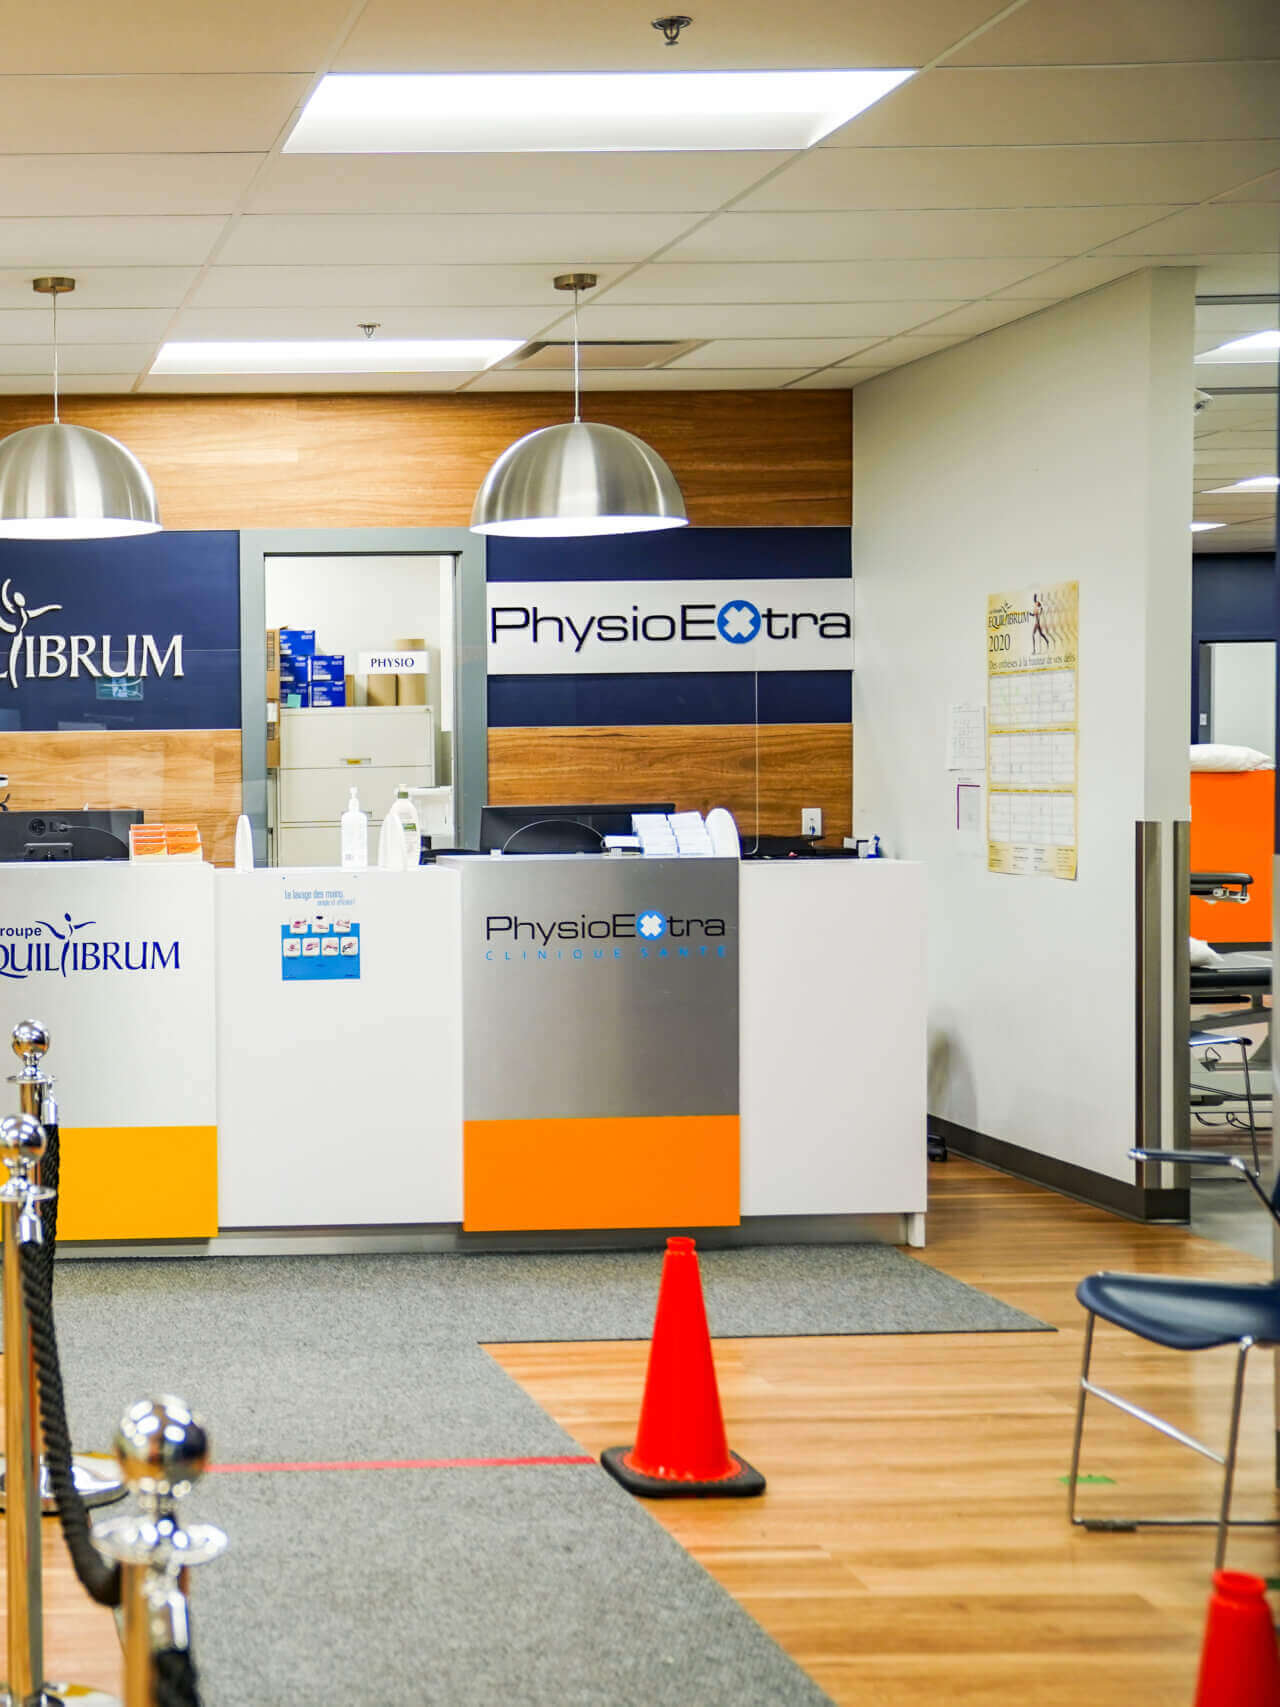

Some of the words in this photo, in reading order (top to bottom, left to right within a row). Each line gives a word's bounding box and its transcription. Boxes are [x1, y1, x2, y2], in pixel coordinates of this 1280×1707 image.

[989, 633, 1011, 653] 2020
[370, 657, 416, 668] PHYSIO
[485, 949, 622, 961] CLINIQUE
